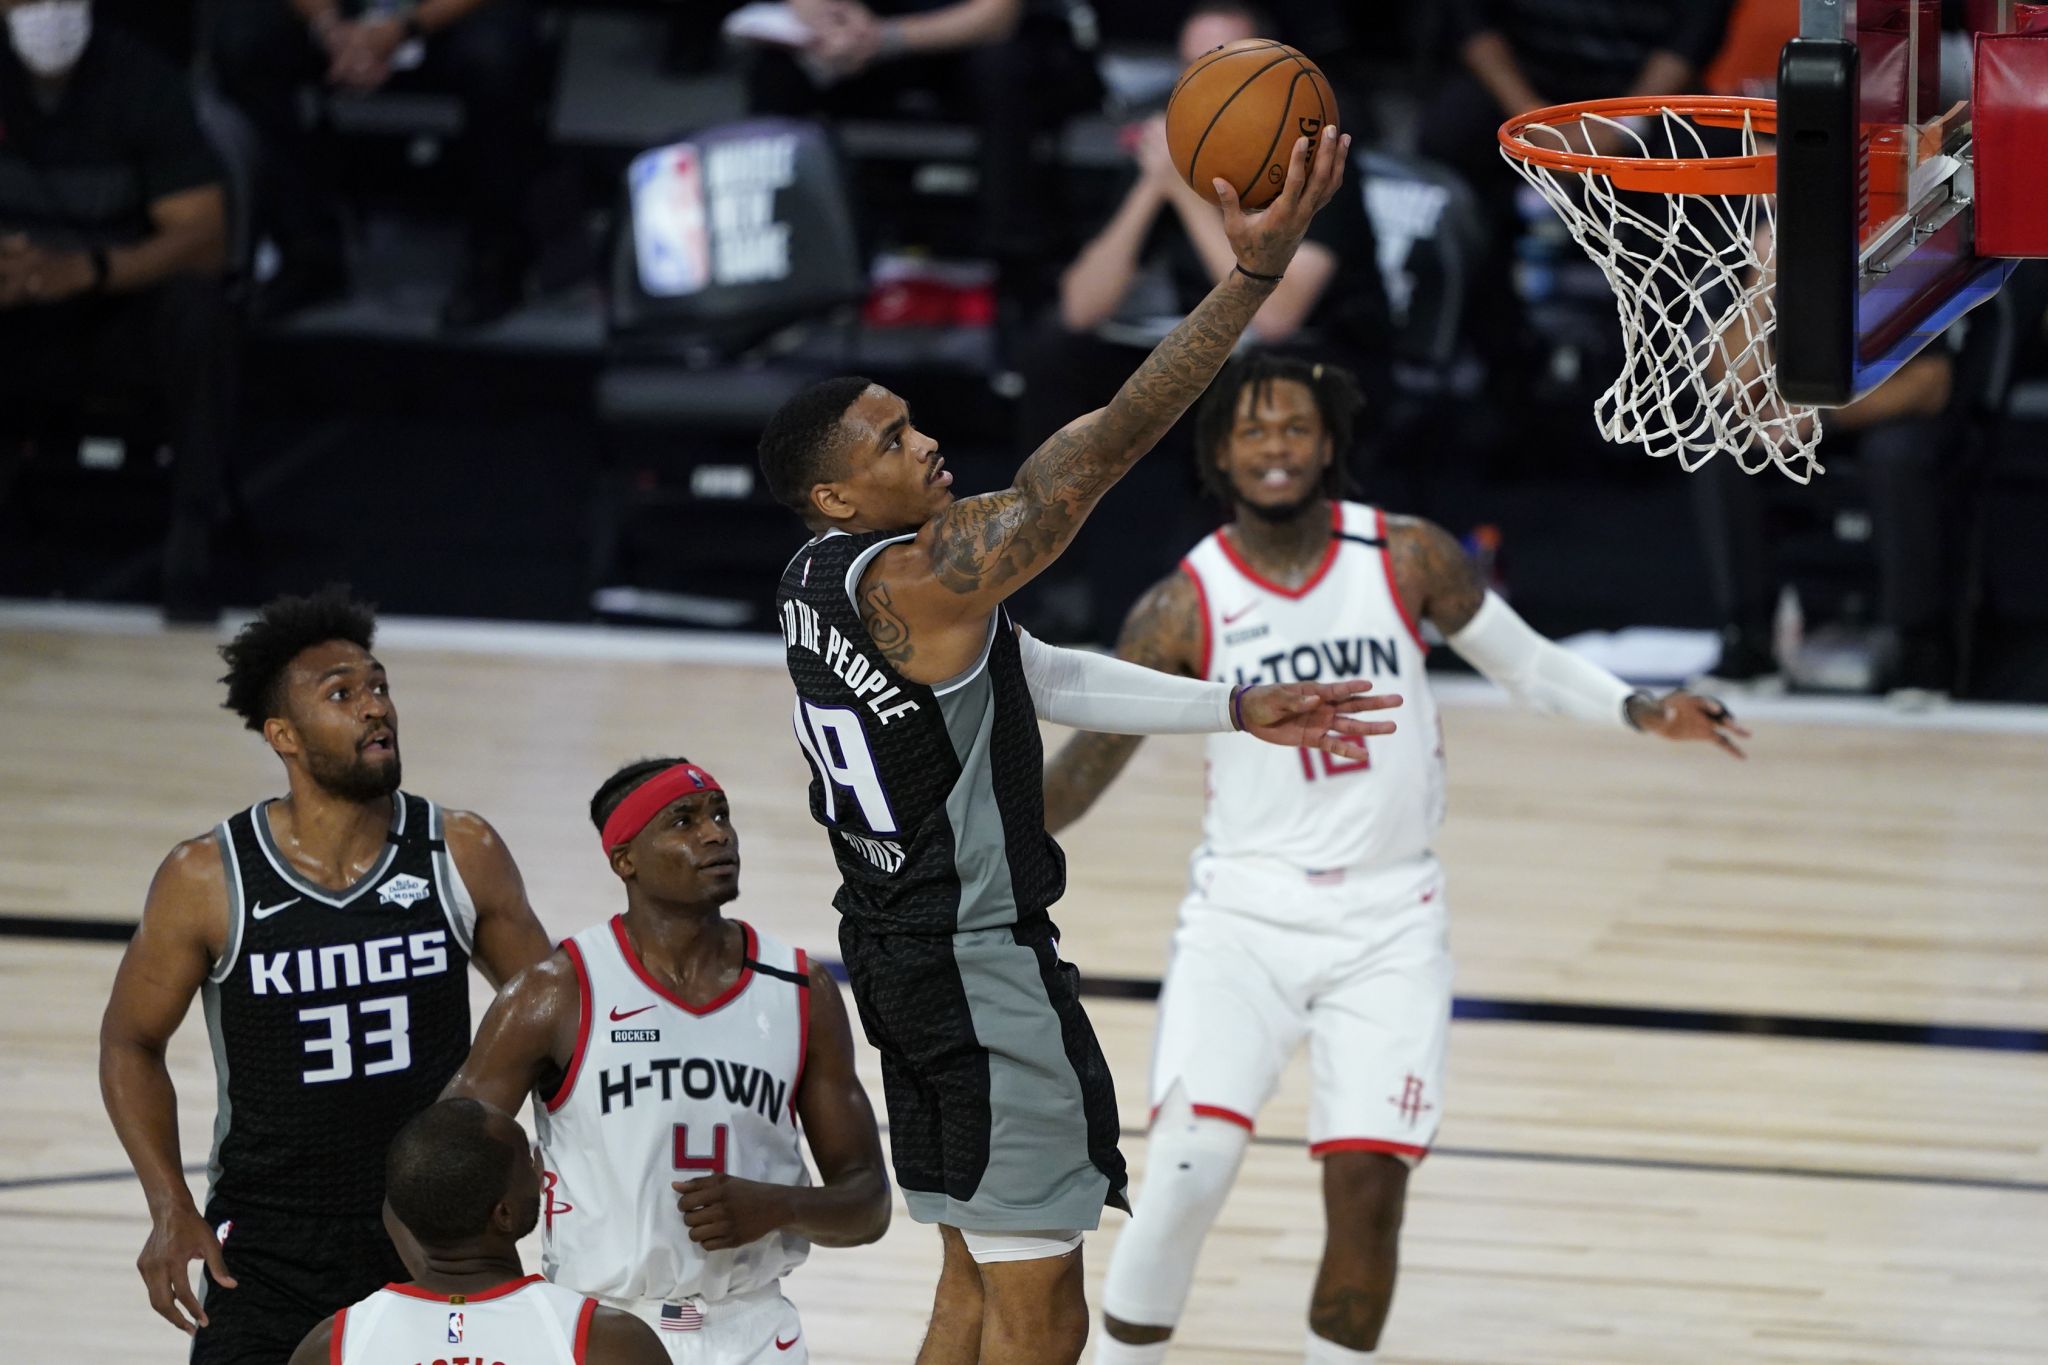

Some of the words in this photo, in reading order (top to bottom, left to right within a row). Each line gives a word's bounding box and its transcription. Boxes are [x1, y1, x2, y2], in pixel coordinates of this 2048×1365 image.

[795, 599, 821, 656] THE
[825, 625, 920, 725] PEOPLE
[793, 694, 899, 834] 19
[382, 888, 428, 902] ALMONDS
[250, 929, 448, 995] KINGS
[299, 995, 411, 1083] 33
[615, 1030, 656, 1042] ROCKETS
[599, 1057, 786, 1125] H-TOWN
[672, 1123, 729, 1174] 4
